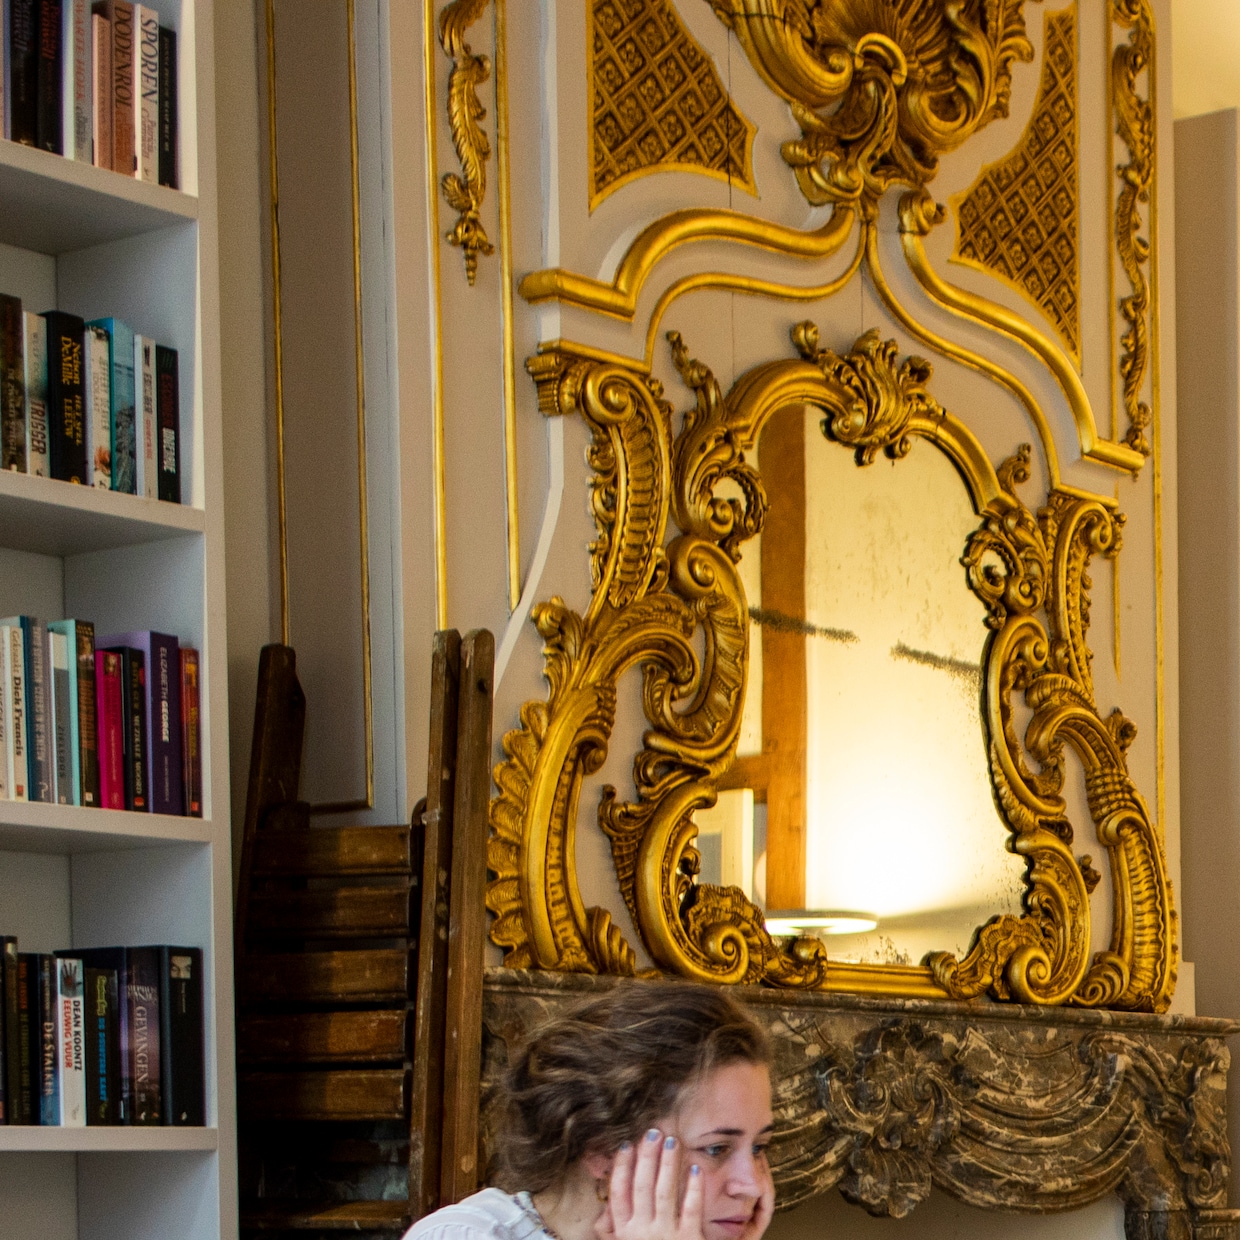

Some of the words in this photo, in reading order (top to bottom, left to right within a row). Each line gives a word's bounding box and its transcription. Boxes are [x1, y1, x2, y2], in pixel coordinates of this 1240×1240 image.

[114, 6, 132, 109] DODENROL
[141, 14, 158, 104] SPOREN
[61, 336, 73, 386] DeMille
[71, 342, 81, 385] Nelson
[31, 400, 46, 455] TRIGGER
[63, 398, 73, 438] LEEUW
[13, 676, 22, 705] Dick
[159, 647, 168, 700] ELIZABETH
[14, 708, 23, 757] Francis
[161, 700, 170, 743] GEORGE
[64, 1000, 72, 1039] EEUWIG
[73, 1000, 81, 1028] DEAN
[74, 1030, 82, 1071] KOONTZ
[135, 1006, 148, 1084] GEVANGEN
[44, 1044, 55, 1097] STALKER
